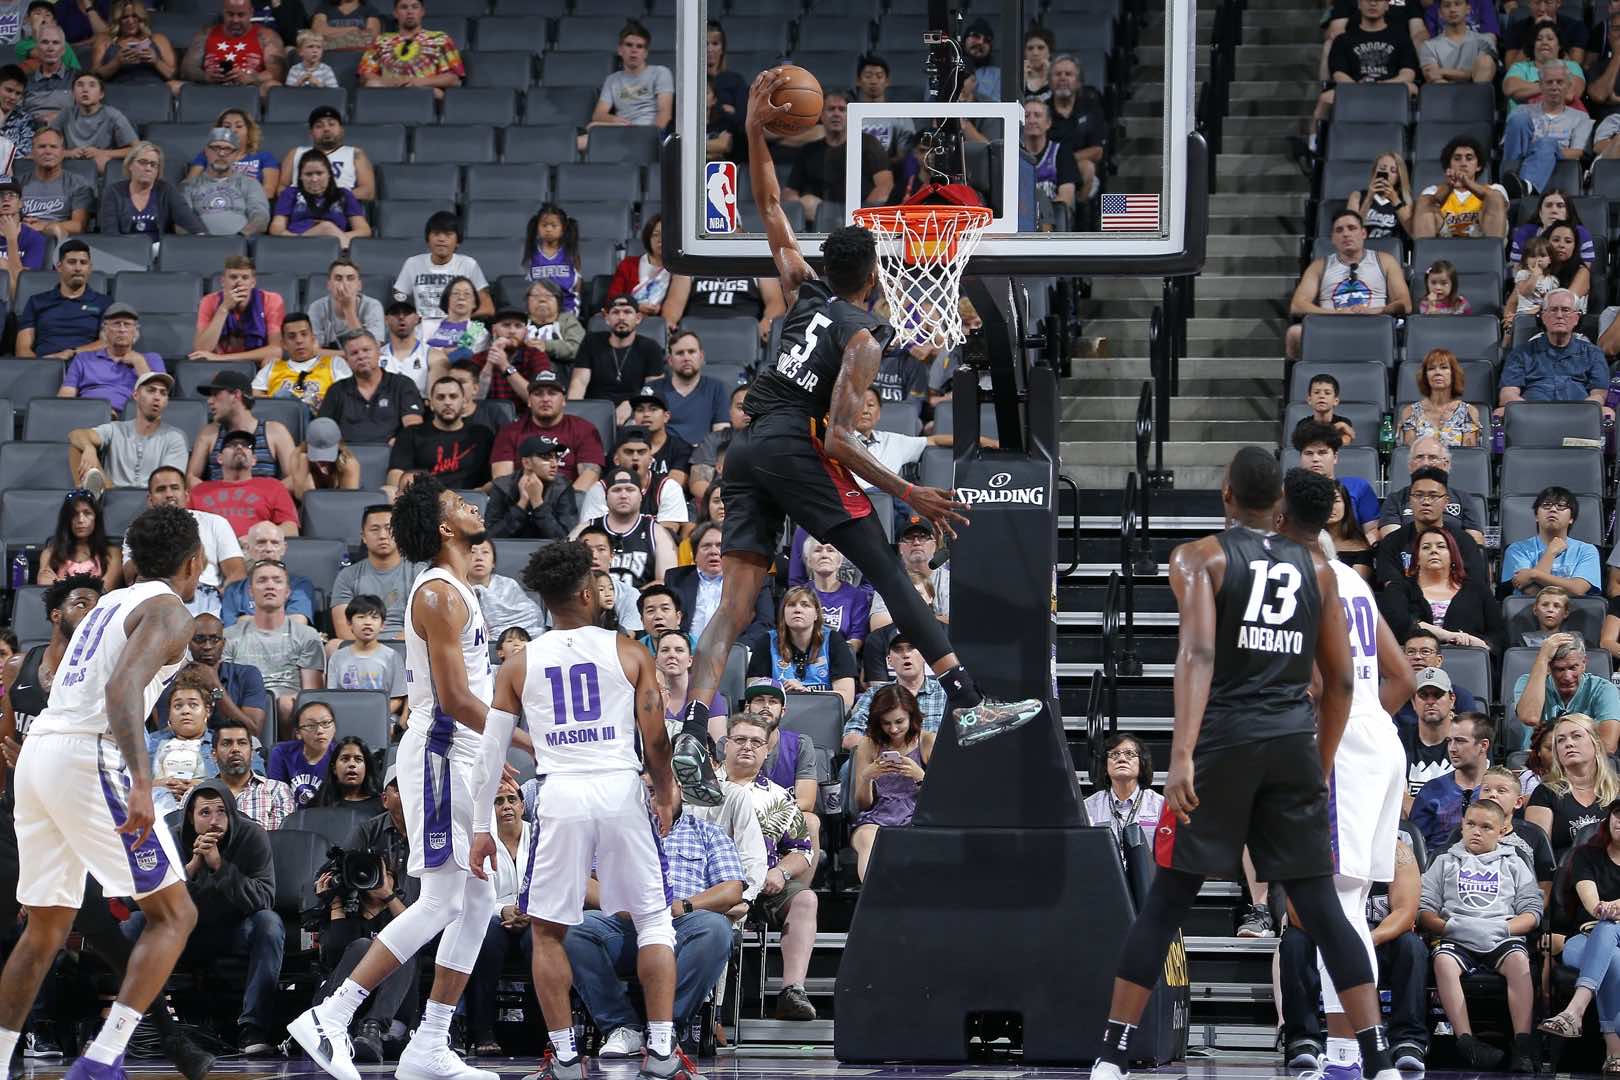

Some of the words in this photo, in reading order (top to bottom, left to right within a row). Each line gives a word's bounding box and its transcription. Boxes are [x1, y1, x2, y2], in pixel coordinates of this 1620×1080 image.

[709, 217, 725, 229] NBA
[696, 279, 749, 292] KINGS
[708, 292, 735, 305] 10
[790, 311, 834, 363] 5
[796, 369, 819, 393] JR
[956, 486, 1044, 506] SPALDING
[1243, 560, 1302, 625] 13
[1237, 625, 1304, 655] ADEBAYO
[544, 662, 601, 726] 10
[545, 729, 598, 747] MASON
[602, 726, 616, 741] III
[1458, 882, 1499, 894] KINGS
